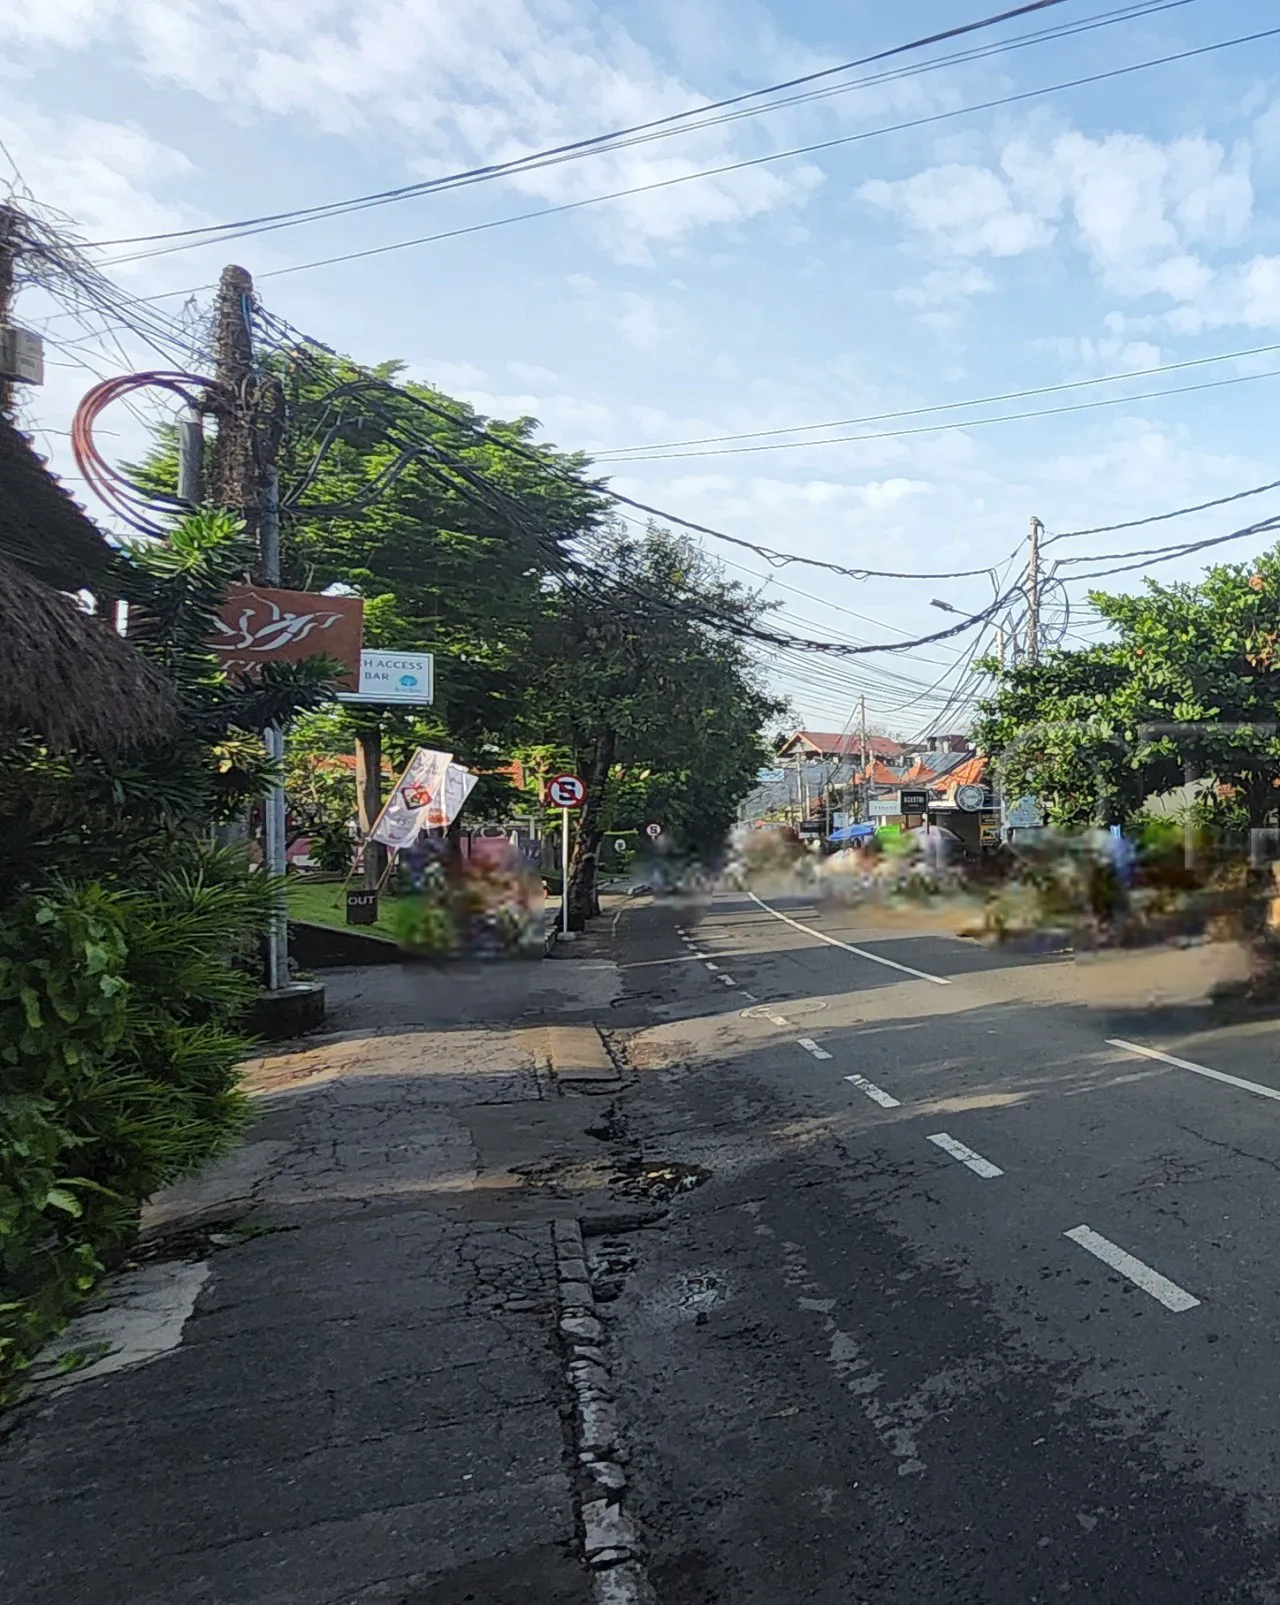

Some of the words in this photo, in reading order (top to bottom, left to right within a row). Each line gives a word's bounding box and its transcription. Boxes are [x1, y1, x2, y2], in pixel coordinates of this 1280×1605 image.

[376, 660, 423, 670] ACCESS
[364, 671, 390, 681] BAR
[347, 895, 376, 905] OUT
